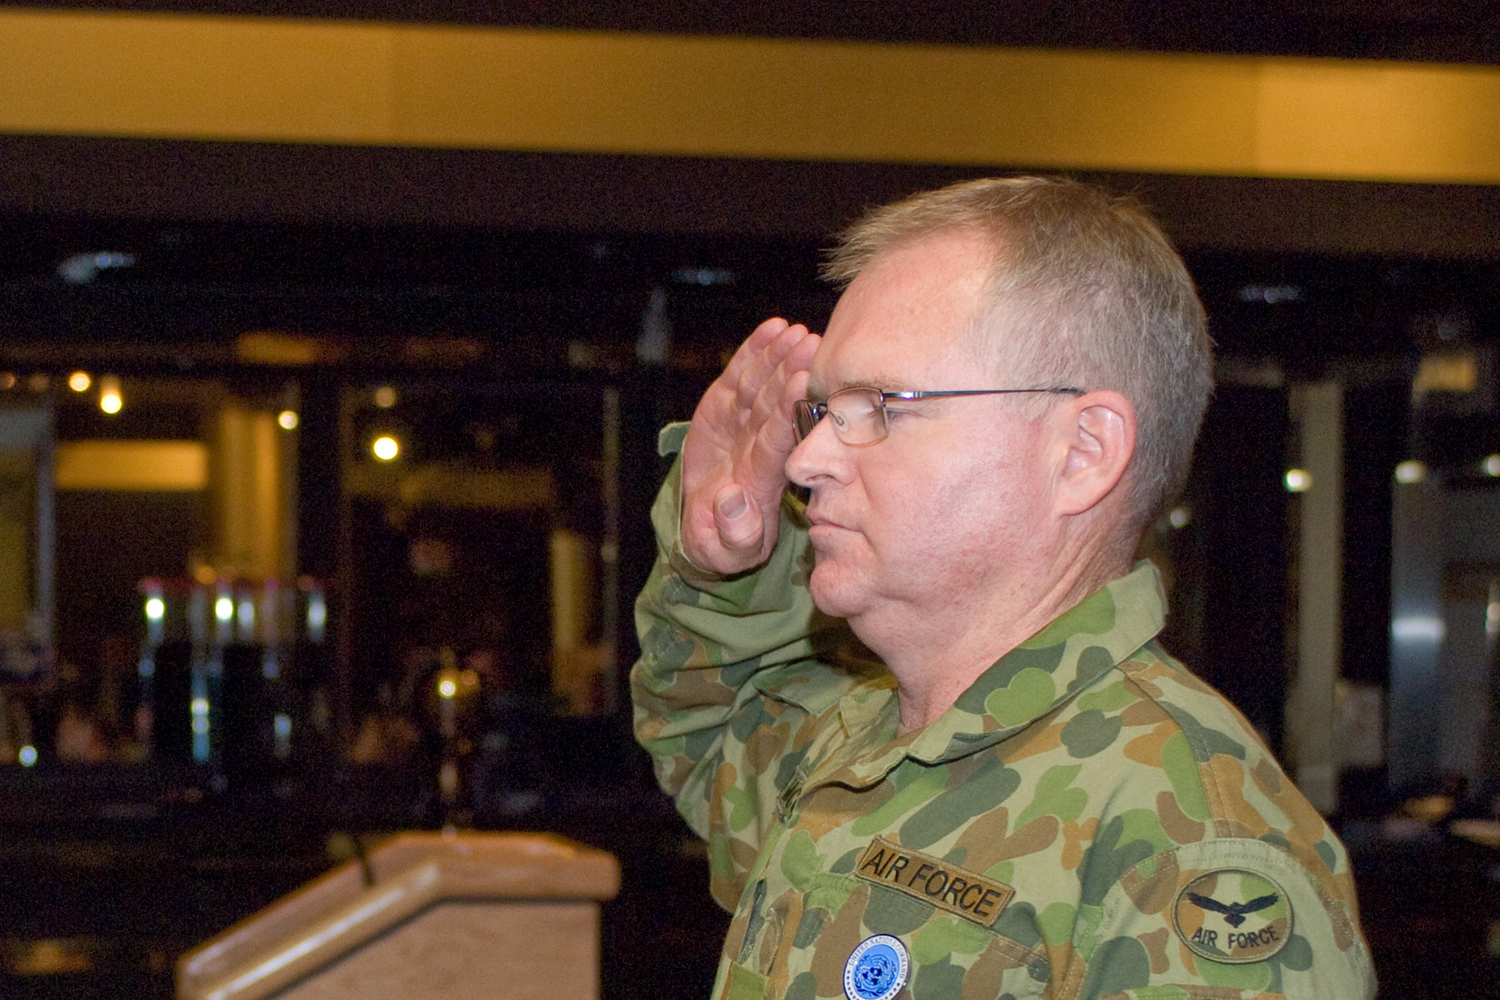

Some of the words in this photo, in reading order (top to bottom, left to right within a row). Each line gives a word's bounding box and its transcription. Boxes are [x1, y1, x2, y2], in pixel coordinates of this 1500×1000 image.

[861, 848, 909, 883] AIR
[907, 863, 1001, 917] FORCE
[1191, 926, 1218, 947] AIR
[1228, 925, 1280, 949] FORCE
